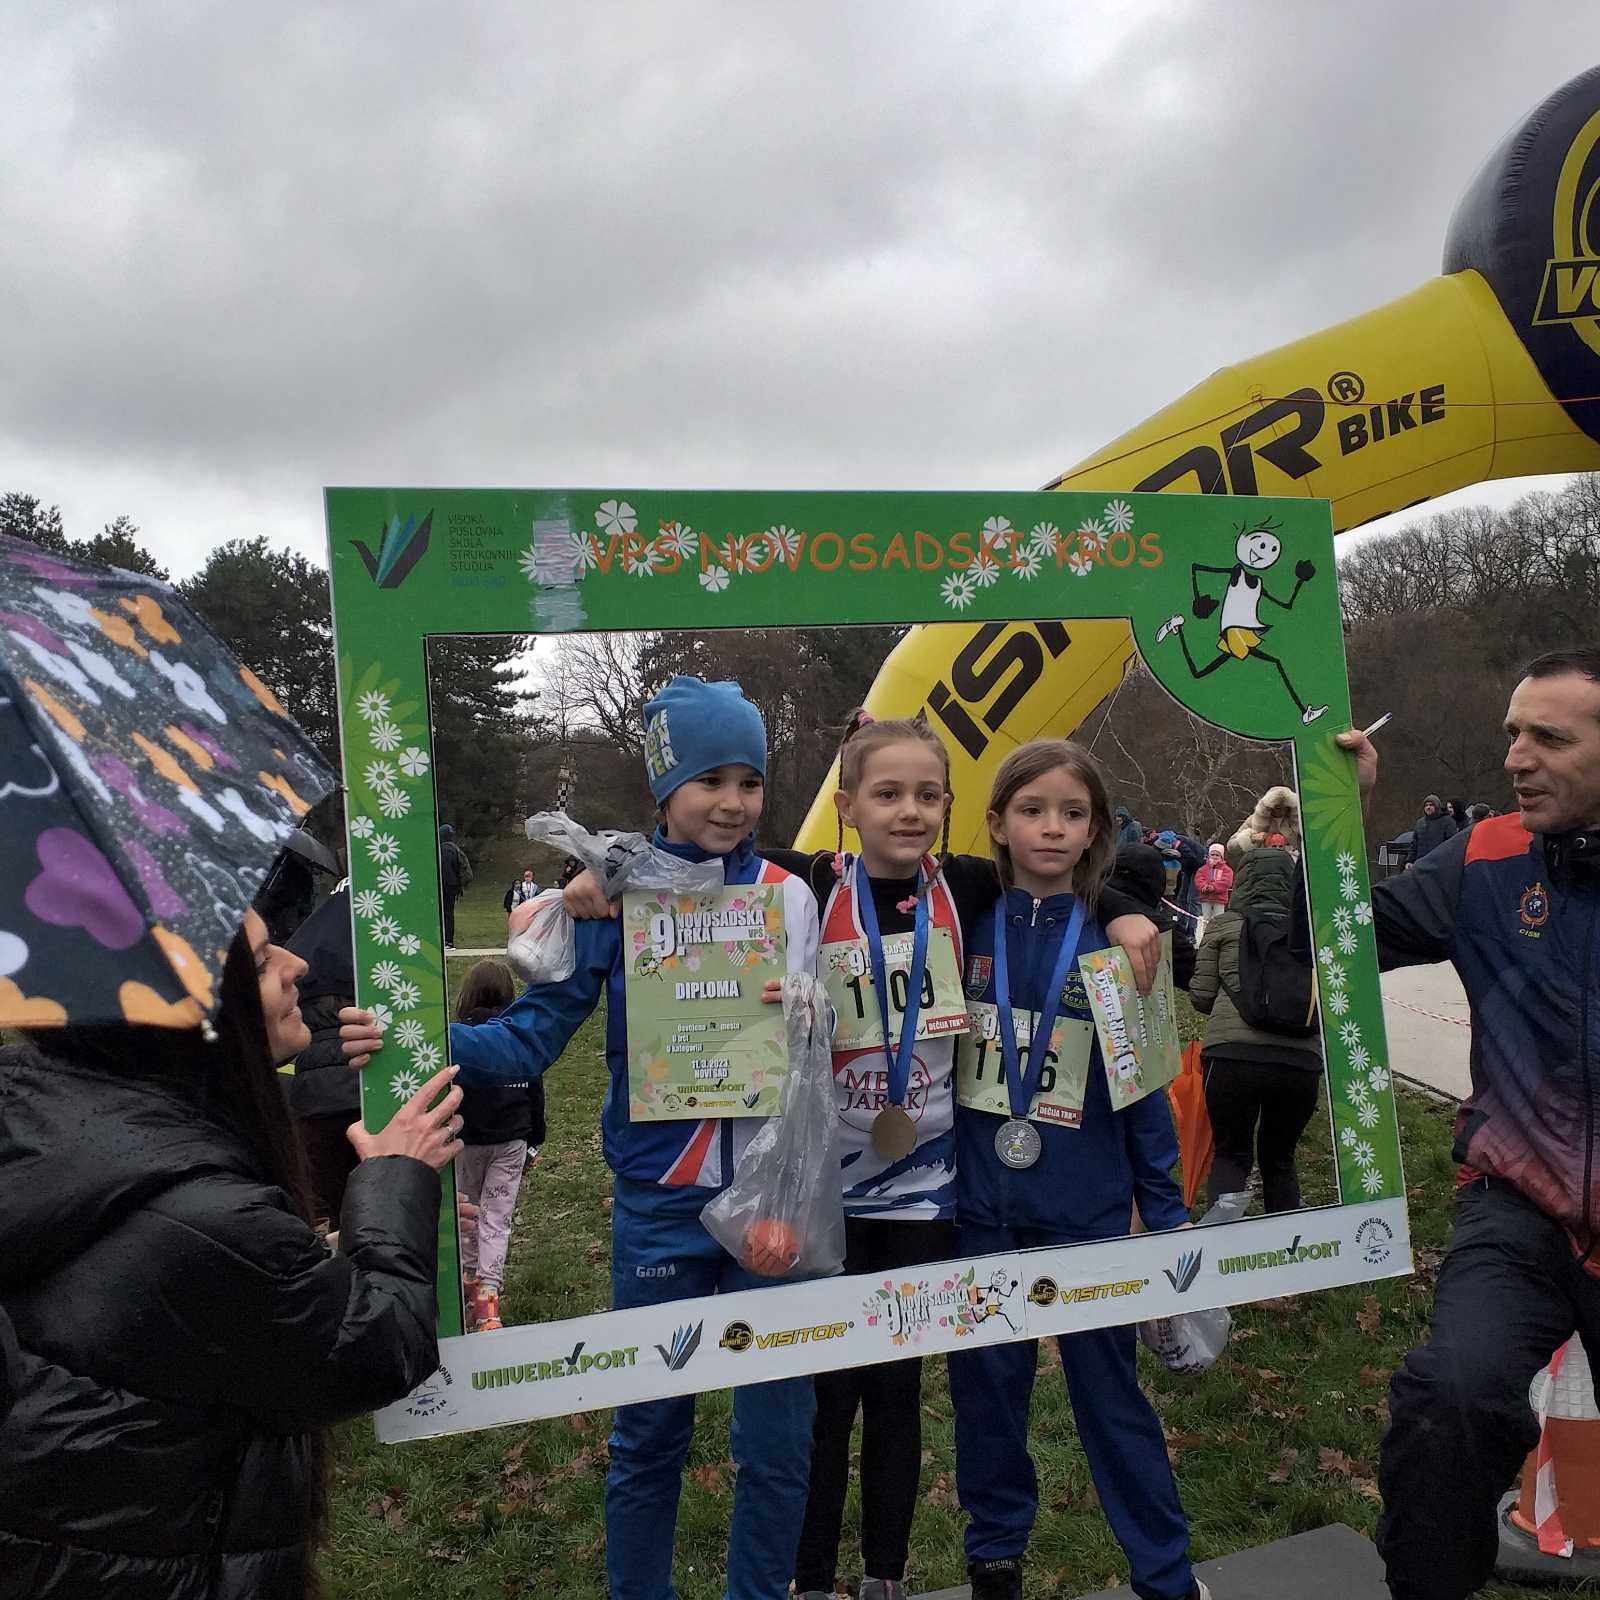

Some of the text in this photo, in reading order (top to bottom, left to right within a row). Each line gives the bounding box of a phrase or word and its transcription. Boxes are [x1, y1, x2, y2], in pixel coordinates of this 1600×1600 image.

[1337, 384, 1445, 456] BIKE
[588, 519, 1164, 575] VPŠ NOVOSADSKI KROS
[676, 910, 765, 929] NOVOSADSKA
[677, 927, 713, 944] TRKA
[1519, 928, 1541, 939] CISM
[675, 980, 741, 1000] DIPLOMA
[1217, 1235, 1342, 1275] UNIVEREXPORT
[471, 1342, 639, 1390] UNIVEREXPORT
[405, 1399, 447, 1417] APATIN
